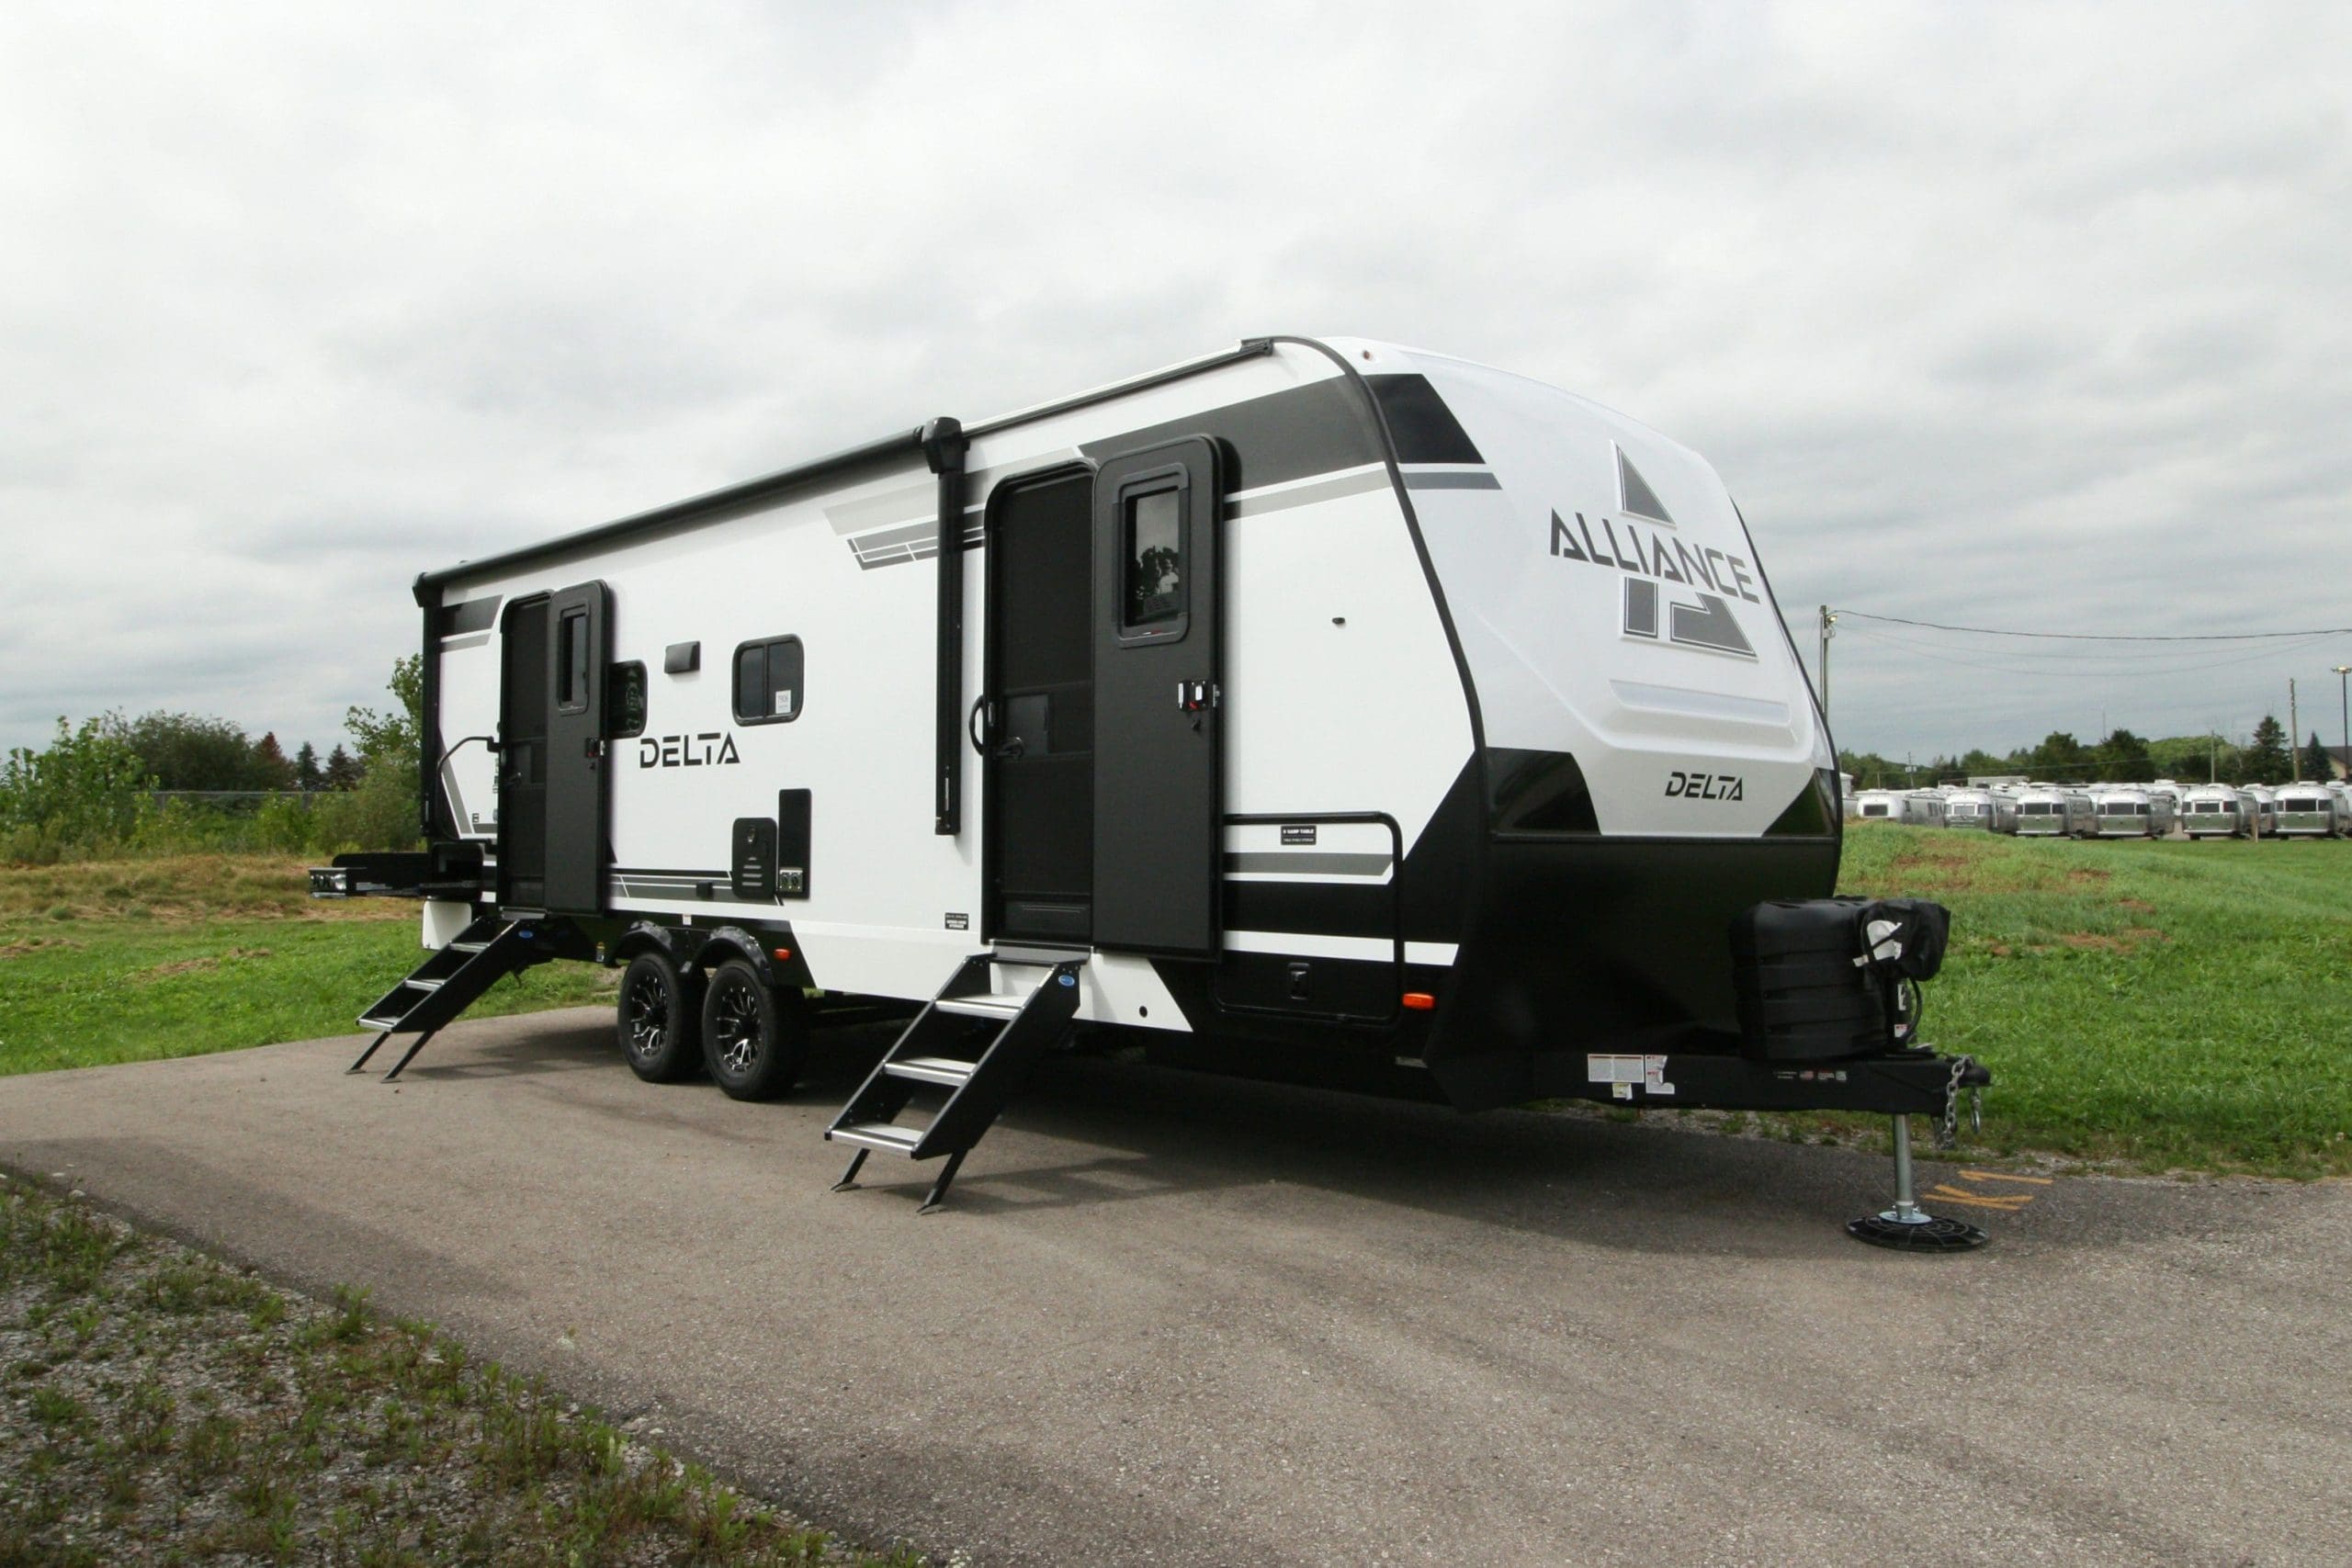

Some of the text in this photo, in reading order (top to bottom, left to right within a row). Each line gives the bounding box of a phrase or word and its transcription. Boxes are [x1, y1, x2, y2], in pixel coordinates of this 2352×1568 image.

[1550, 507, 1760, 604] ALLIANCE
[639, 730, 741, 769] DELTA
[1665, 771, 1743, 801] DELTA
